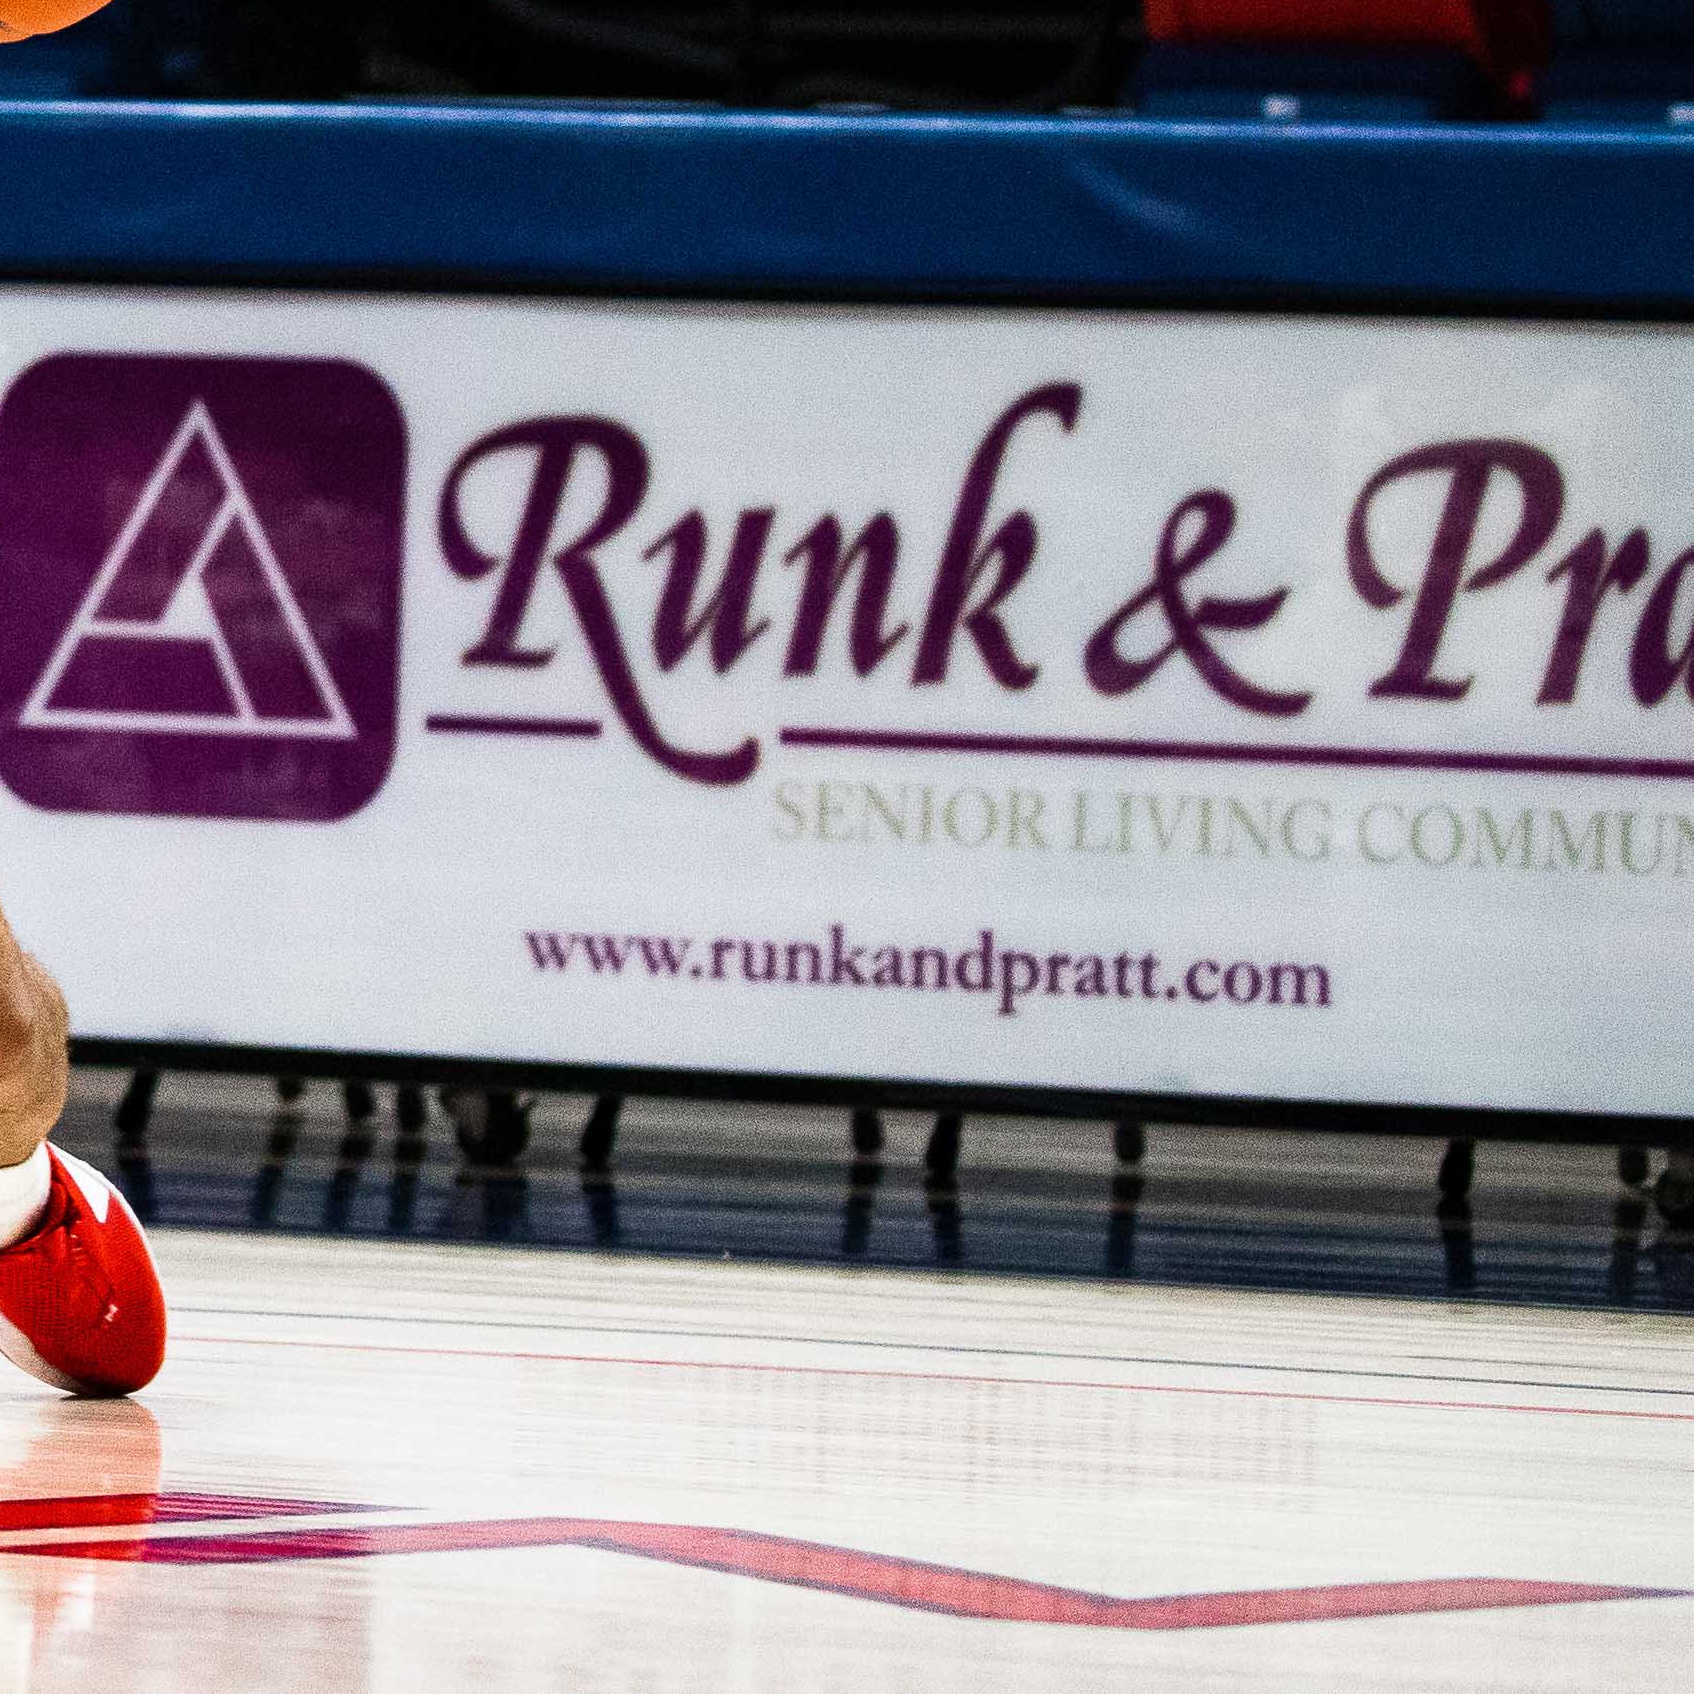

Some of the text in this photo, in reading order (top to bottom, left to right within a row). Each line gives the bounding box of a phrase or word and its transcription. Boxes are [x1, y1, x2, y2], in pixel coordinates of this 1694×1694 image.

[435, 380, 1085, 786] Runk
[1084, 489, 1312, 718] &
[773, 780, 1050, 851] SENIOR
[1070, 789, 1333, 862] LIVING
[523, 921, 1334, 1016] www.runkandpratt.com
